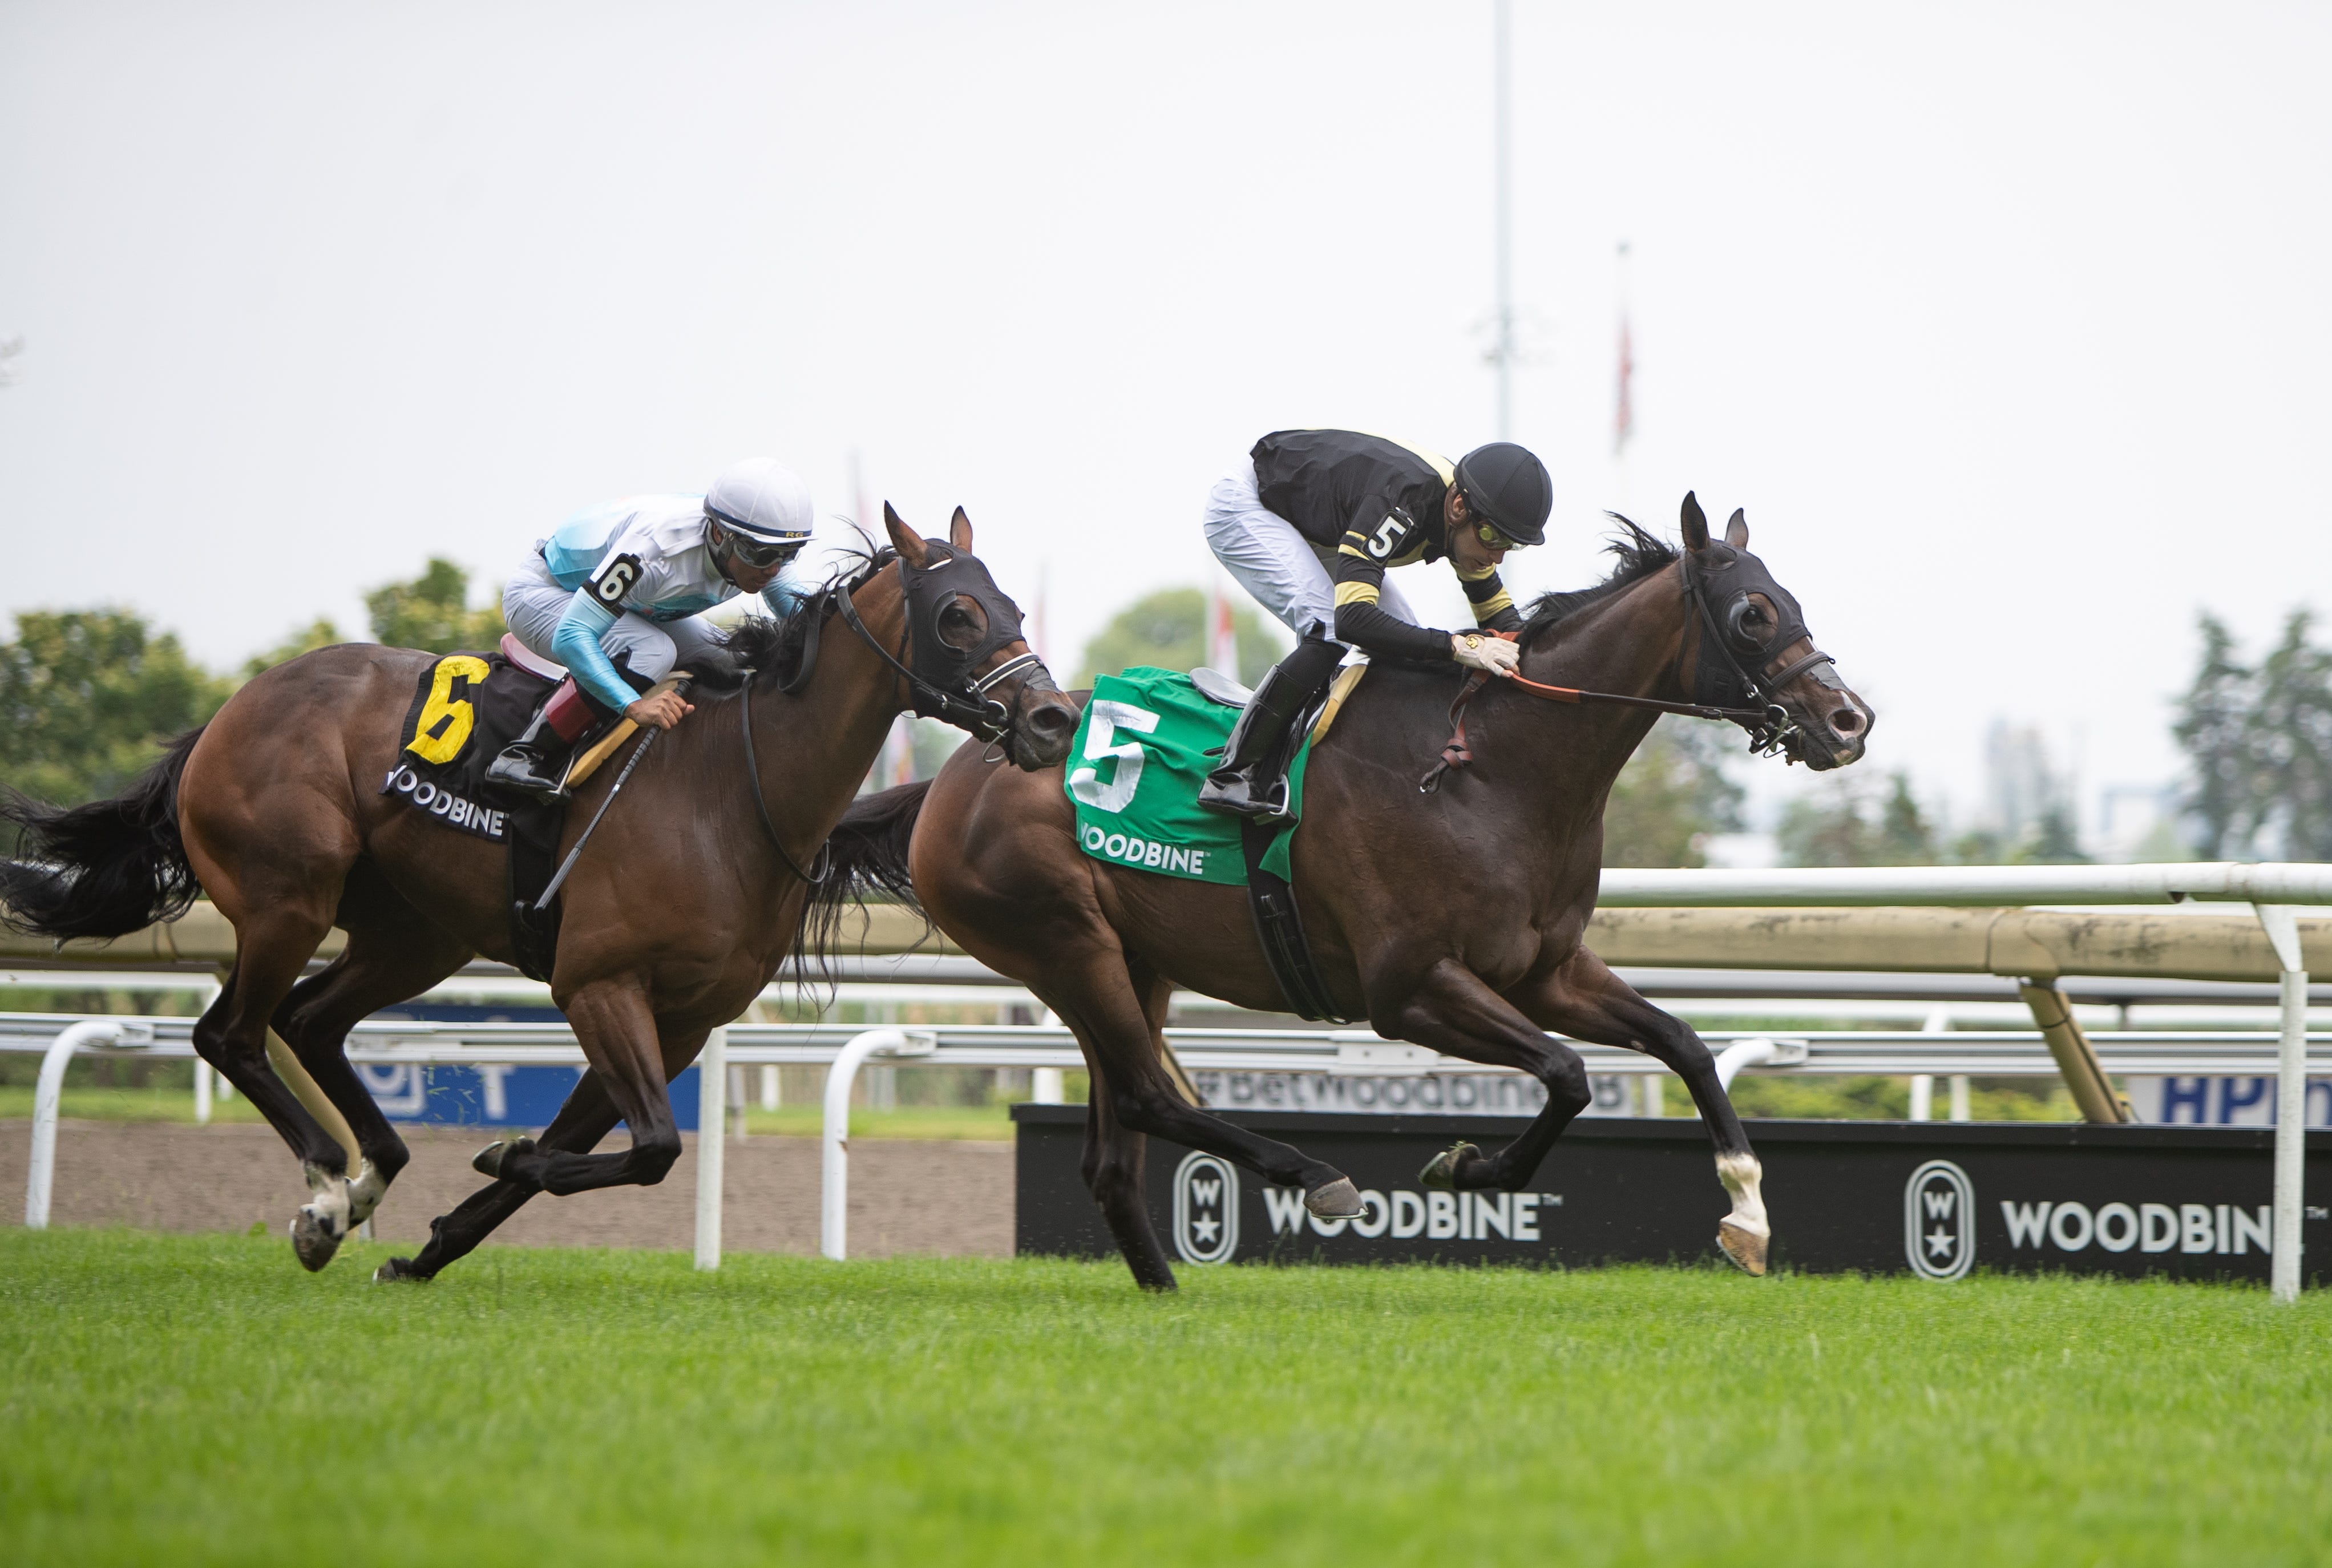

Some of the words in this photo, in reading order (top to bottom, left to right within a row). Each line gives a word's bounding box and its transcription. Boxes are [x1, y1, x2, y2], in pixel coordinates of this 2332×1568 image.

[1368, 515, 1407, 557] 5
[599, 562, 633, 601] 6
[405, 655, 490, 765] 6
[1068, 700, 1161, 814] 5
[1191, 1178, 1221, 1207] W
[1923, 1190, 1955, 1221] W
[1999, 1200, 2305, 1255] WOODBIN
